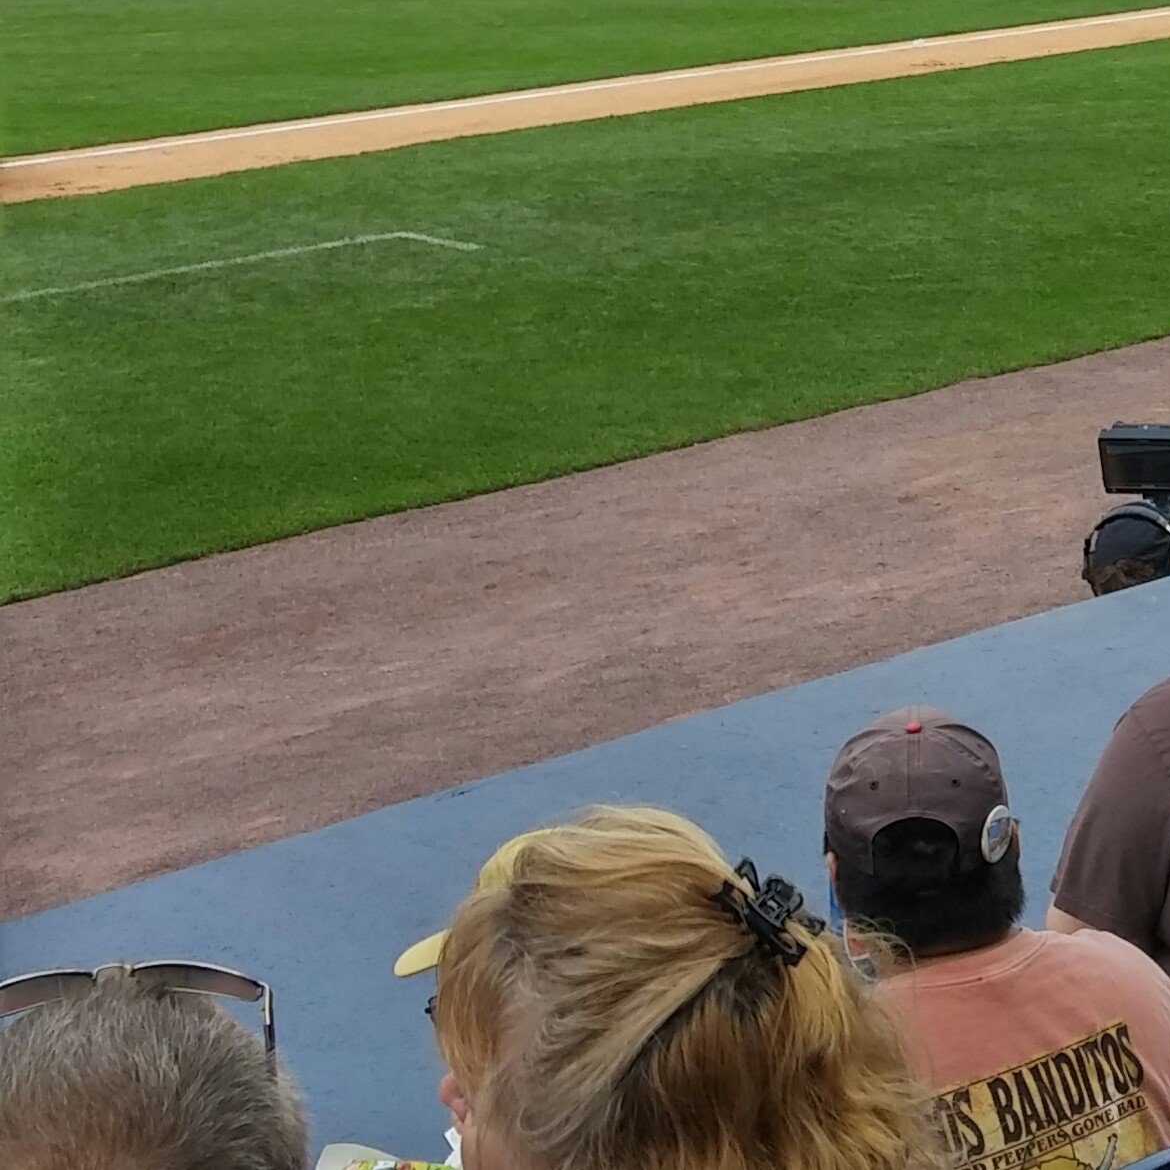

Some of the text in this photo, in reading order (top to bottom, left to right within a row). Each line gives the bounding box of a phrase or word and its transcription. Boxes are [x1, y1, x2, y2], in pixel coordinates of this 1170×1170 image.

[986, 1024, 1145, 1146] BANDITOS
[991, 1095, 1147, 1170] PEPPERS GONE BAD
